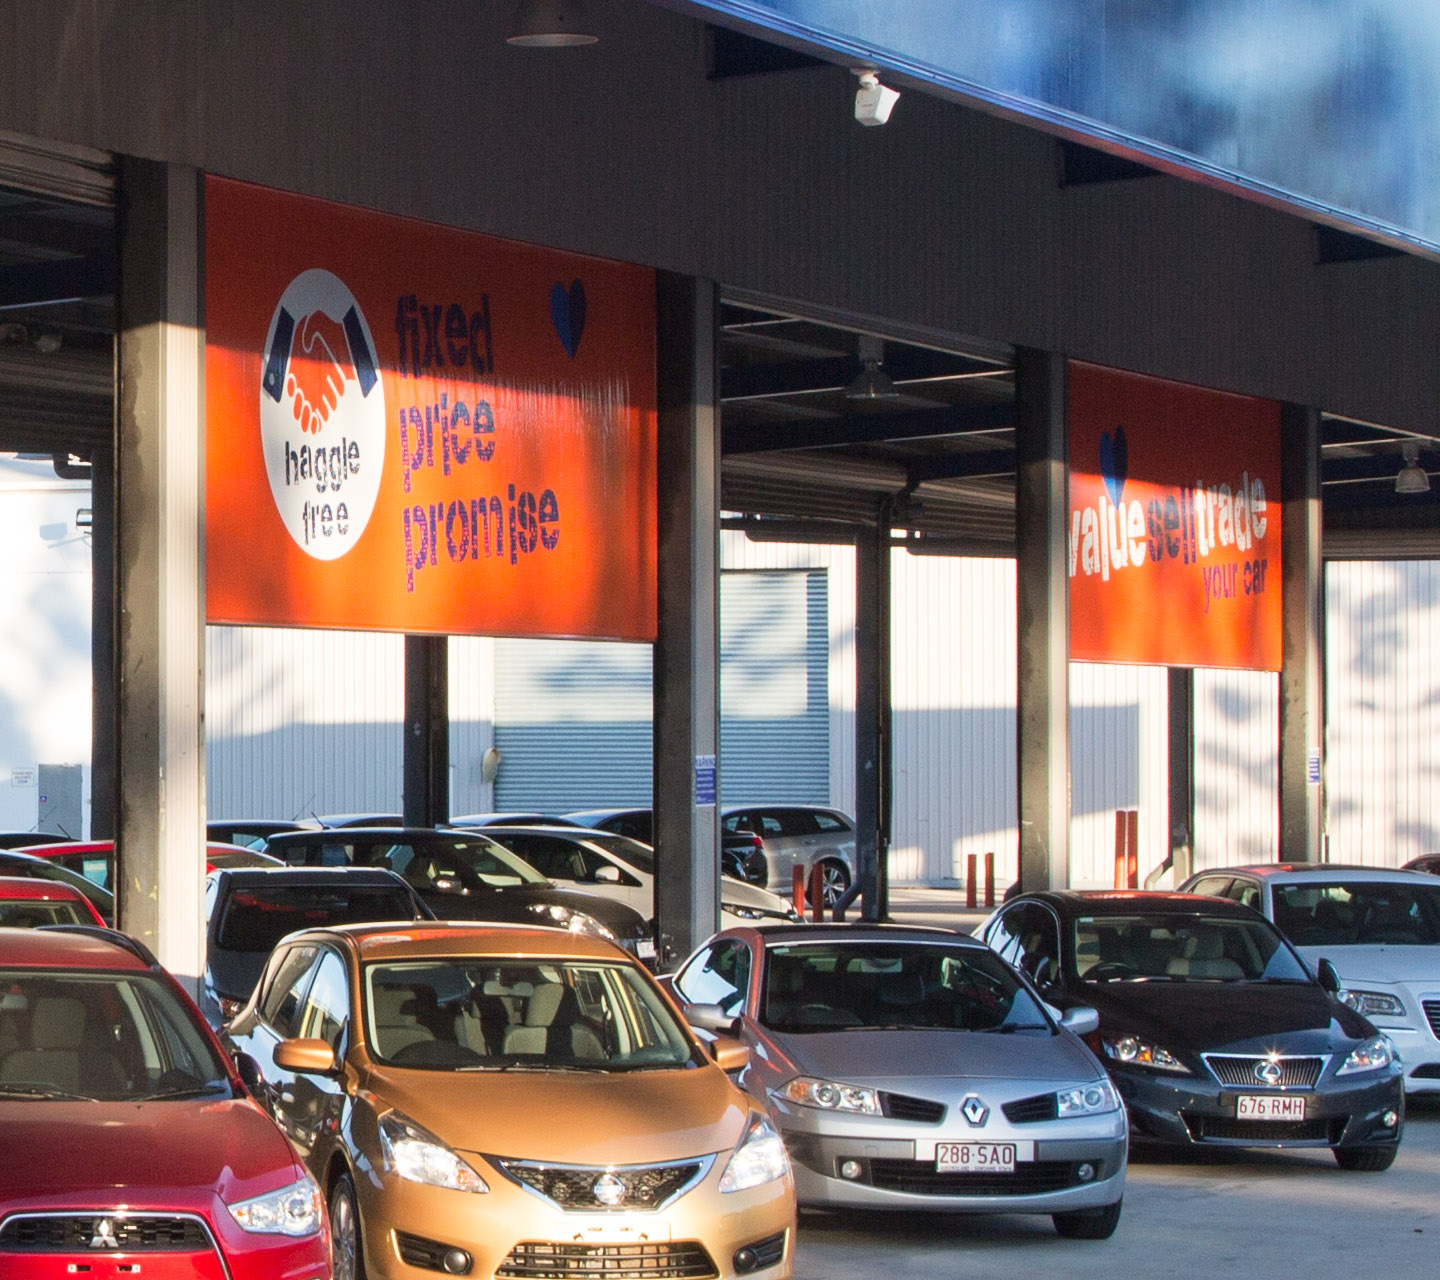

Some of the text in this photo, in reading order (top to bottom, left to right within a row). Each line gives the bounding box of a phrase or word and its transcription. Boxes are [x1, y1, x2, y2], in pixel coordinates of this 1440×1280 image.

[394, 293, 494, 380] fixed
[283, 437, 360, 493] haggle
[399, 392, 496, 494] price
[302, 500, 349, 545] free
[403, 483, 559, 593] promise
[1202, 559, 1267, 614] your car
